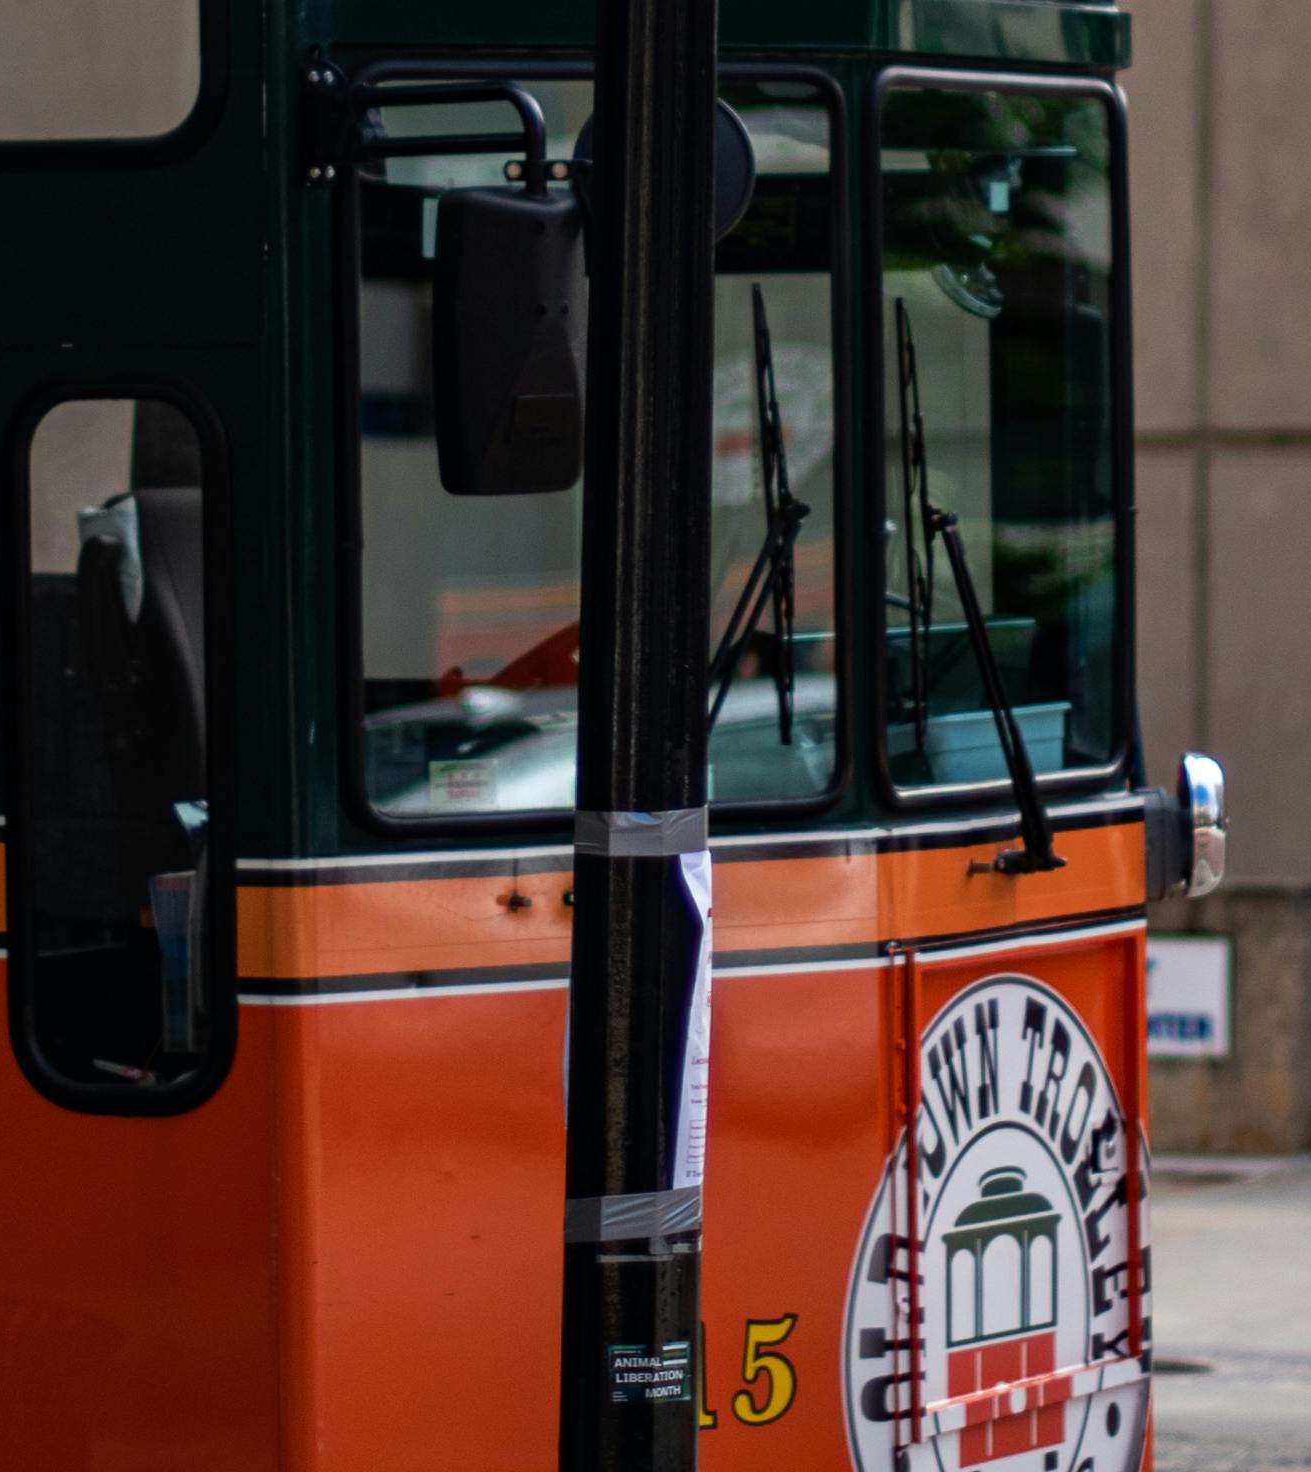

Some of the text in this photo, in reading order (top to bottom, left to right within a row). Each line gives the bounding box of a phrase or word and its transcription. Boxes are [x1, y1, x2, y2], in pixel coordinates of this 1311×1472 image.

[613, 1356, 663, 1369] ANIMAL
[615, 1369, 684, 1384] LIBERATION
[644, 1384, 682, 1399] MONTH
